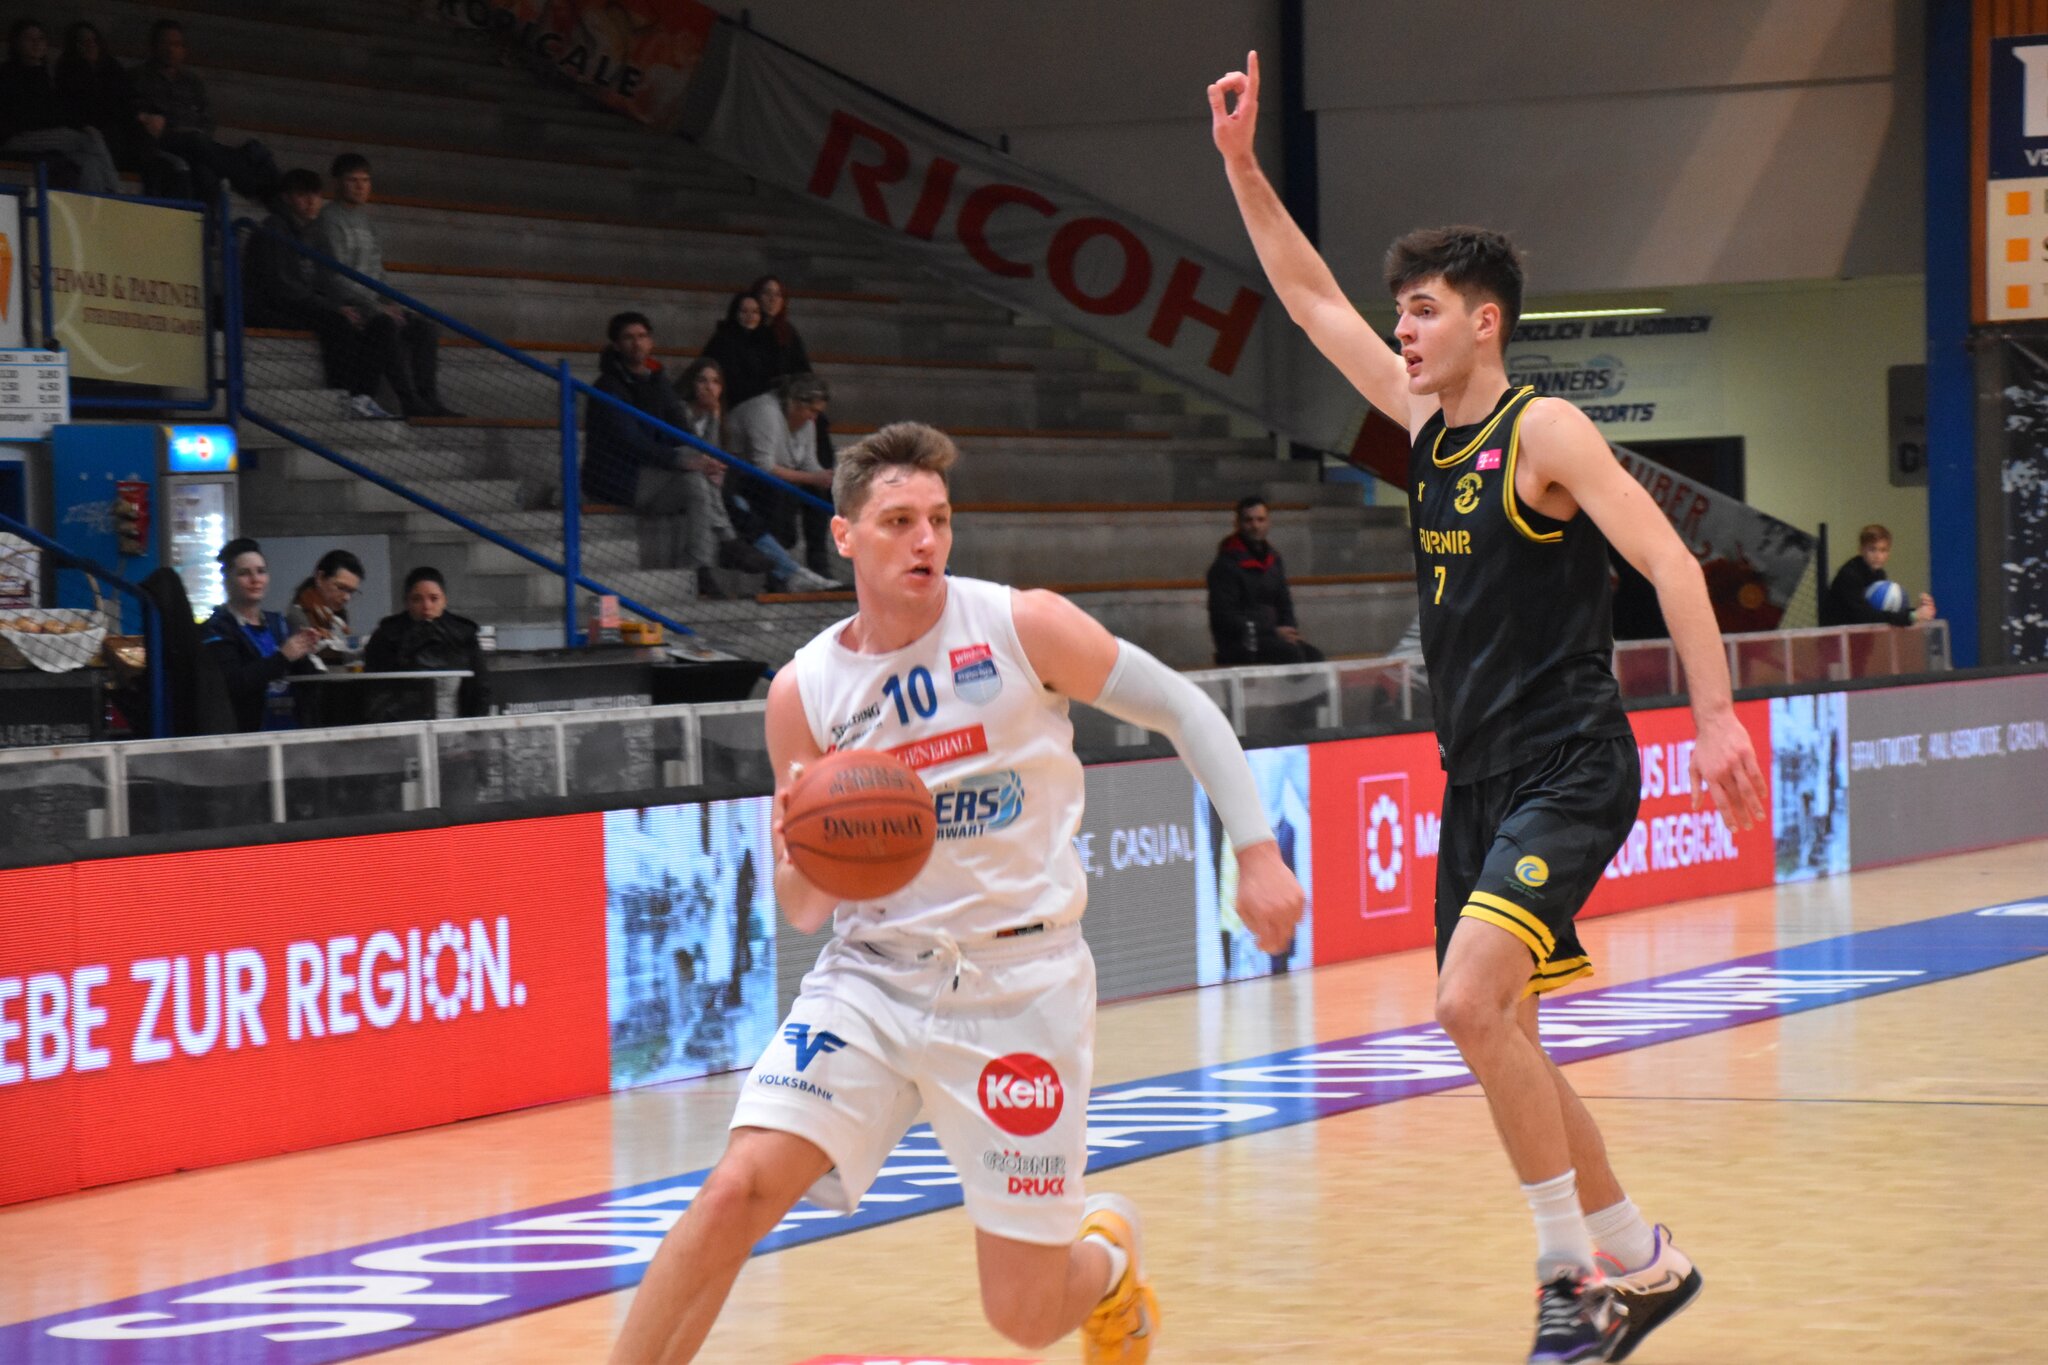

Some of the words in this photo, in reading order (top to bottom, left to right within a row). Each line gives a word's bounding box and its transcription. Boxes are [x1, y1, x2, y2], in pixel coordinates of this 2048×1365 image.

[808, 109, 1265, 377] RICOH
[31, 265, 107, 298] SHWAB
[1512, 321, 1584, 342] ERZLICH
[1419, 528, 1472, 555] FURNIR
[1434, 565, 1446, 605] 7
[882, 665, 938, 726] 10
[1638, 744, 1665, 799] US
[935, 787, 1000, 826] ERS
[1109, 823, 1195, 871] CASUAL
[130, 947, 269, 1065] ZUR
[285, 915, 528, 1041] REGION.
[757, 1073, 833, 1102] VOLKSBANK
[1007, 1176, 1066, 1197] DRUCK
